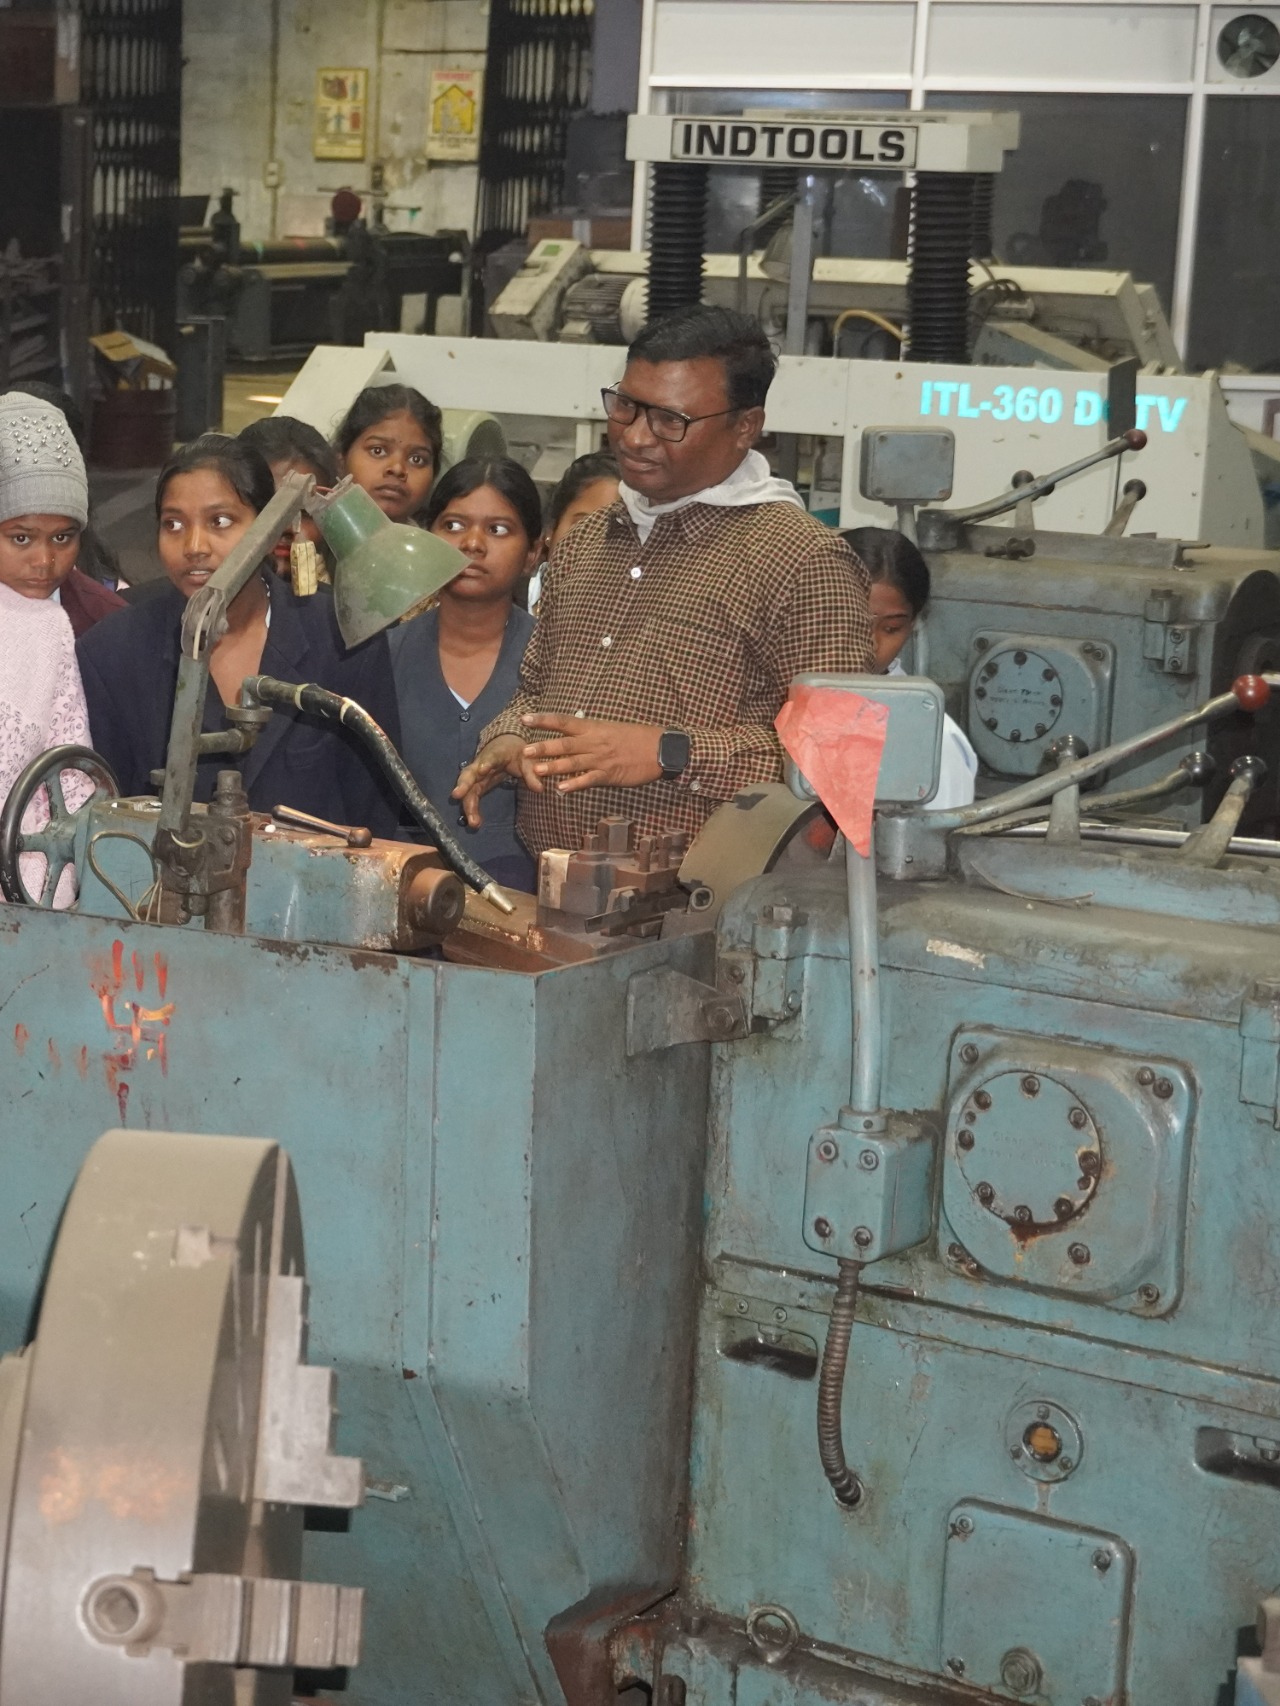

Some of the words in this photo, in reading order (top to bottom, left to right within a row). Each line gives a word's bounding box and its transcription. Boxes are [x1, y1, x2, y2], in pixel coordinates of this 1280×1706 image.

[681, 123, 907, 163] INDTOOLS
[919, 380, 1063, 425] ITL-360
[1073, 389, 1187, 433] DTV
